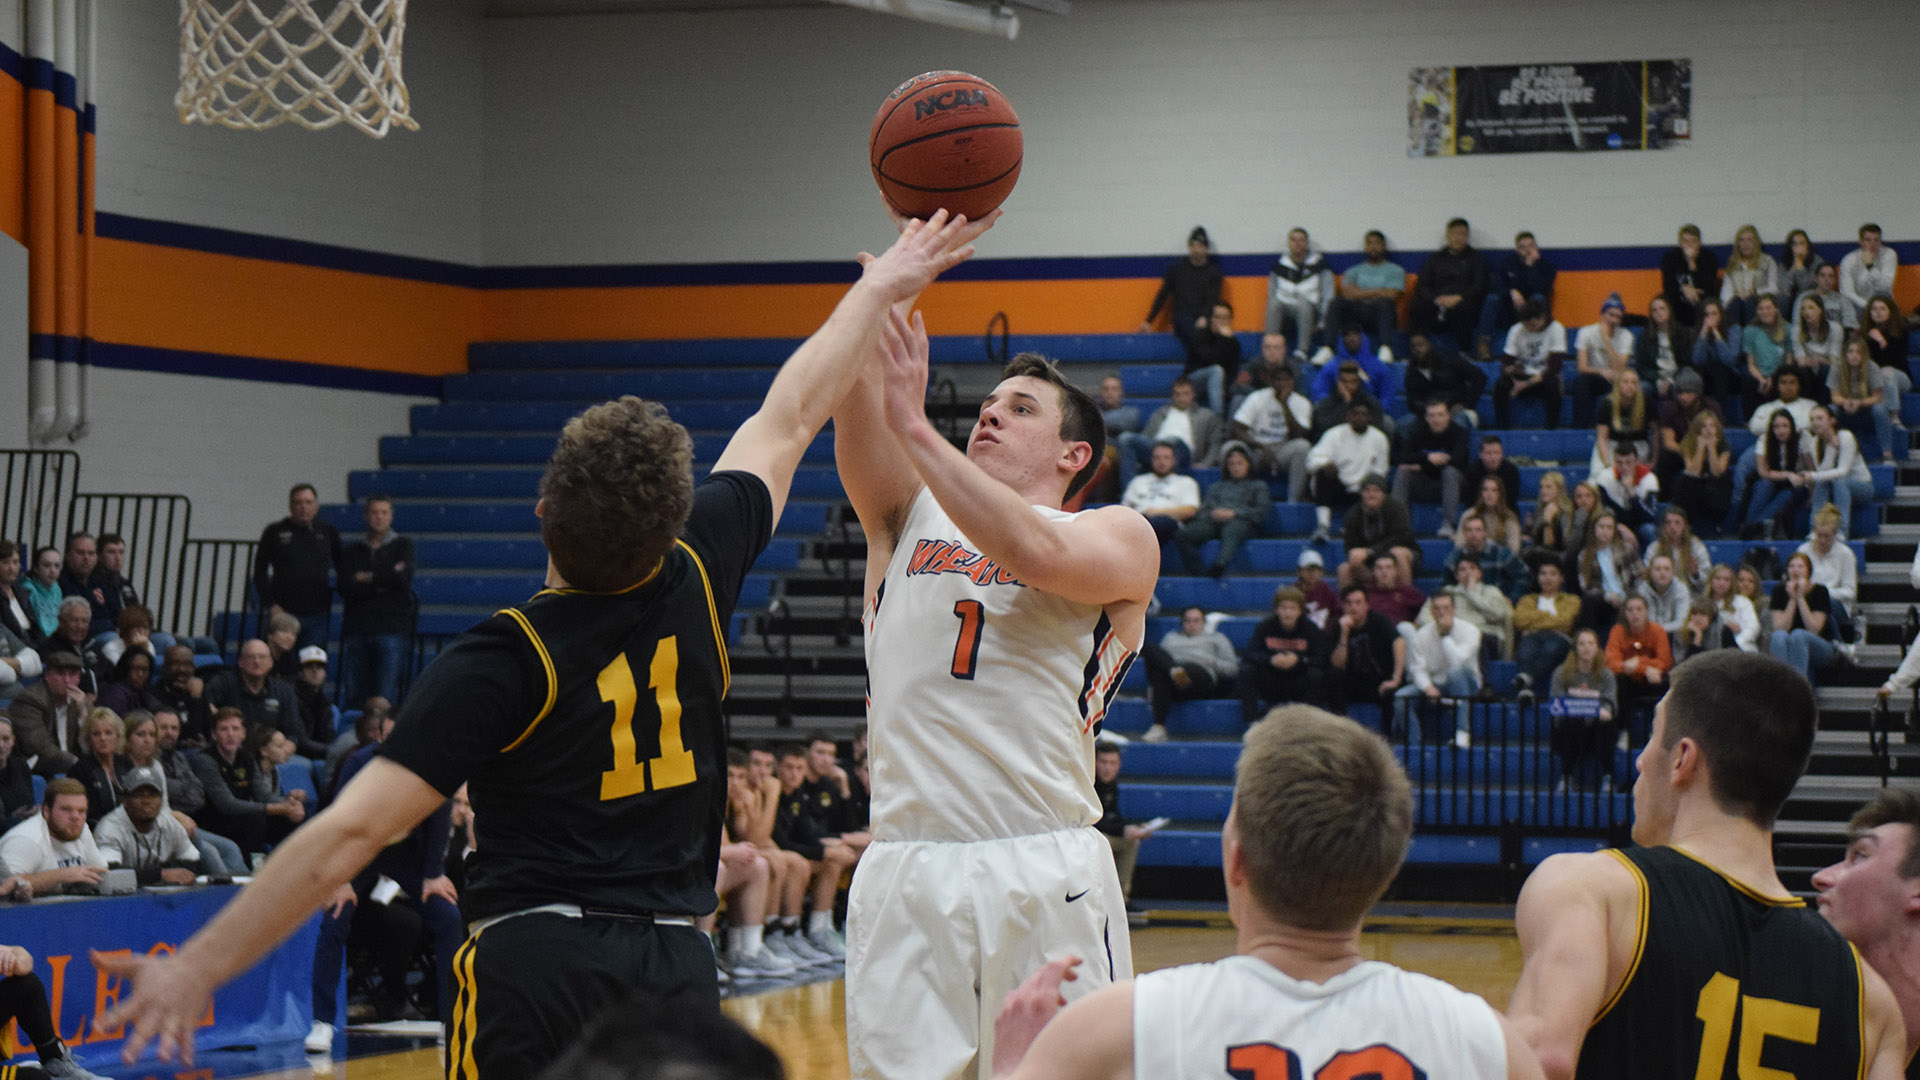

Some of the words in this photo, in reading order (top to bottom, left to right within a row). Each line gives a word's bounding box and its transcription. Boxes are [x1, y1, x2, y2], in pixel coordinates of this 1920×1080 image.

[913, 89, 989, 121] NCAA
[1498, 89, 1520, 106] BE
[906, 538, 1028, 588] WHEAT
[951, 599, 985, 681] 1
[596, 634, 698, 801] 11
